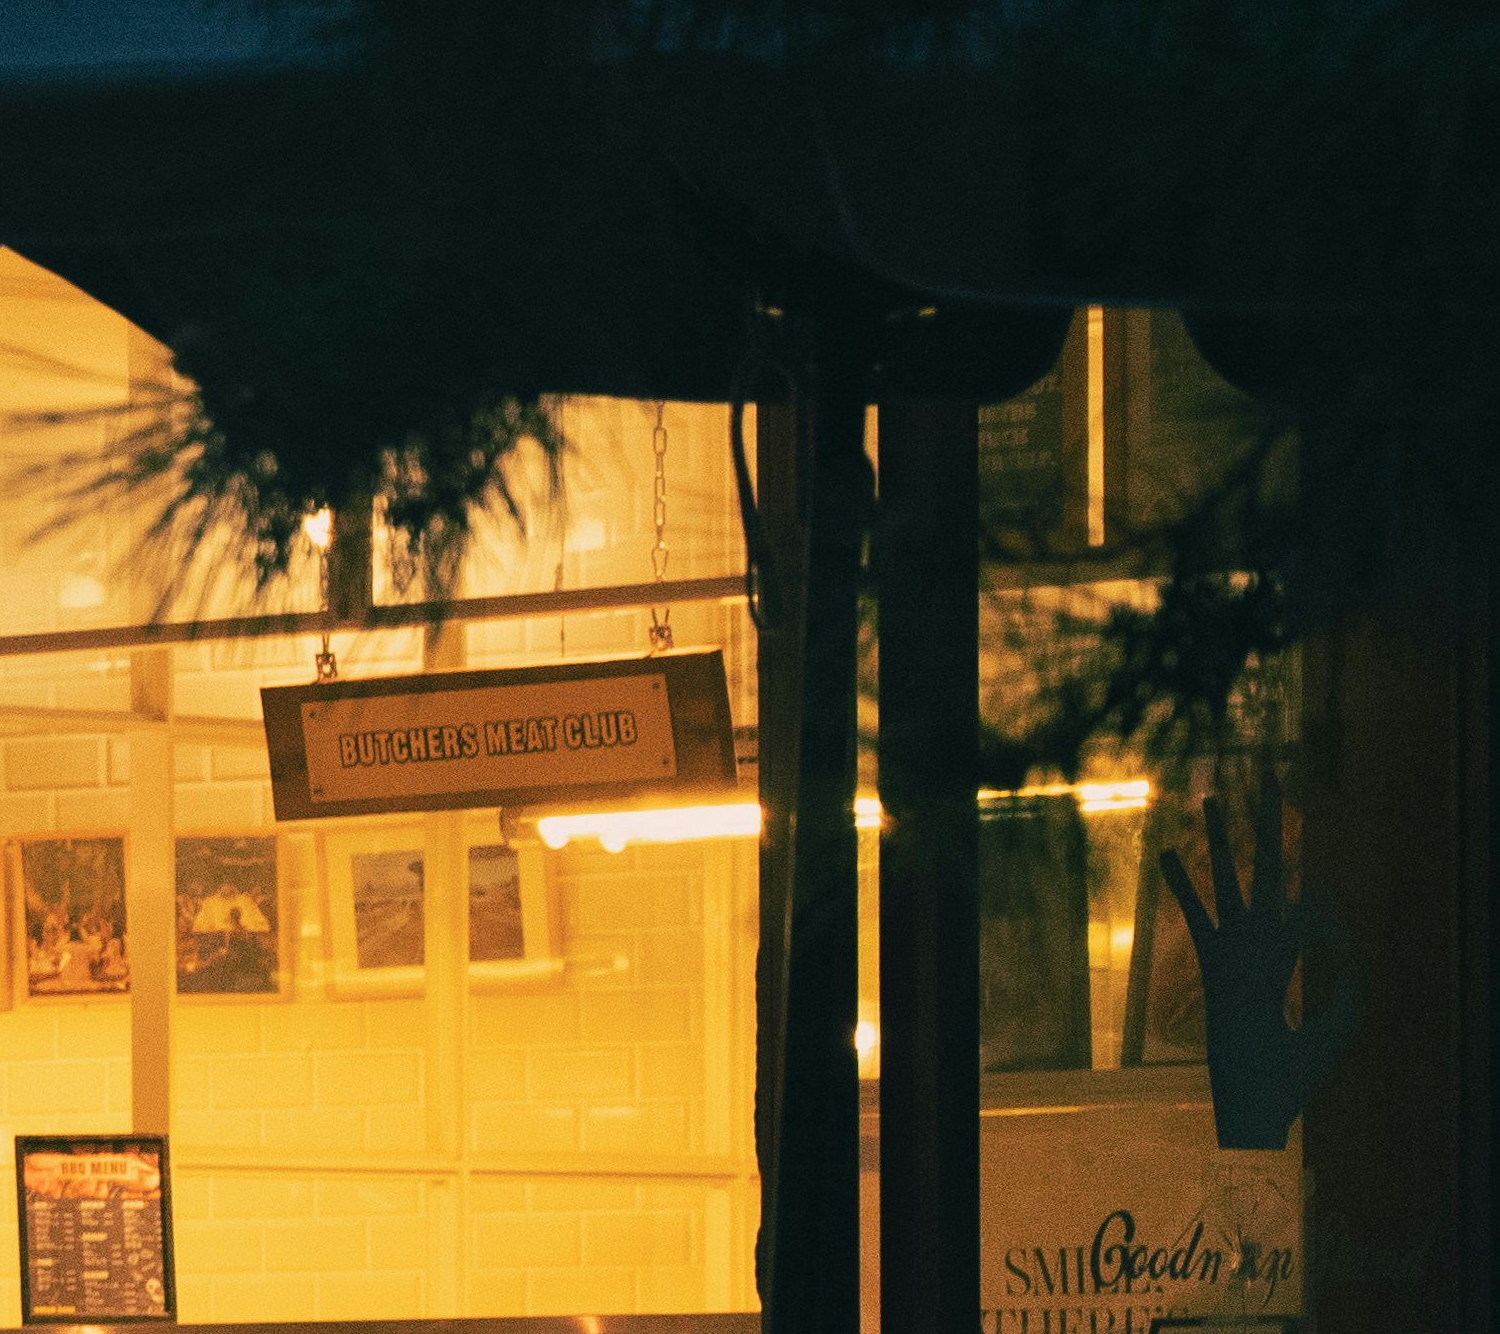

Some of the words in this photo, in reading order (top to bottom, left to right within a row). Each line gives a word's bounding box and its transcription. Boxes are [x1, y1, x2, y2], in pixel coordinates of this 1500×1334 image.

[340, 723, 479, 768] BUTCHERS
[485, 718, 559, 756] MEAT
[563, 711, 638, 750] CLUB
